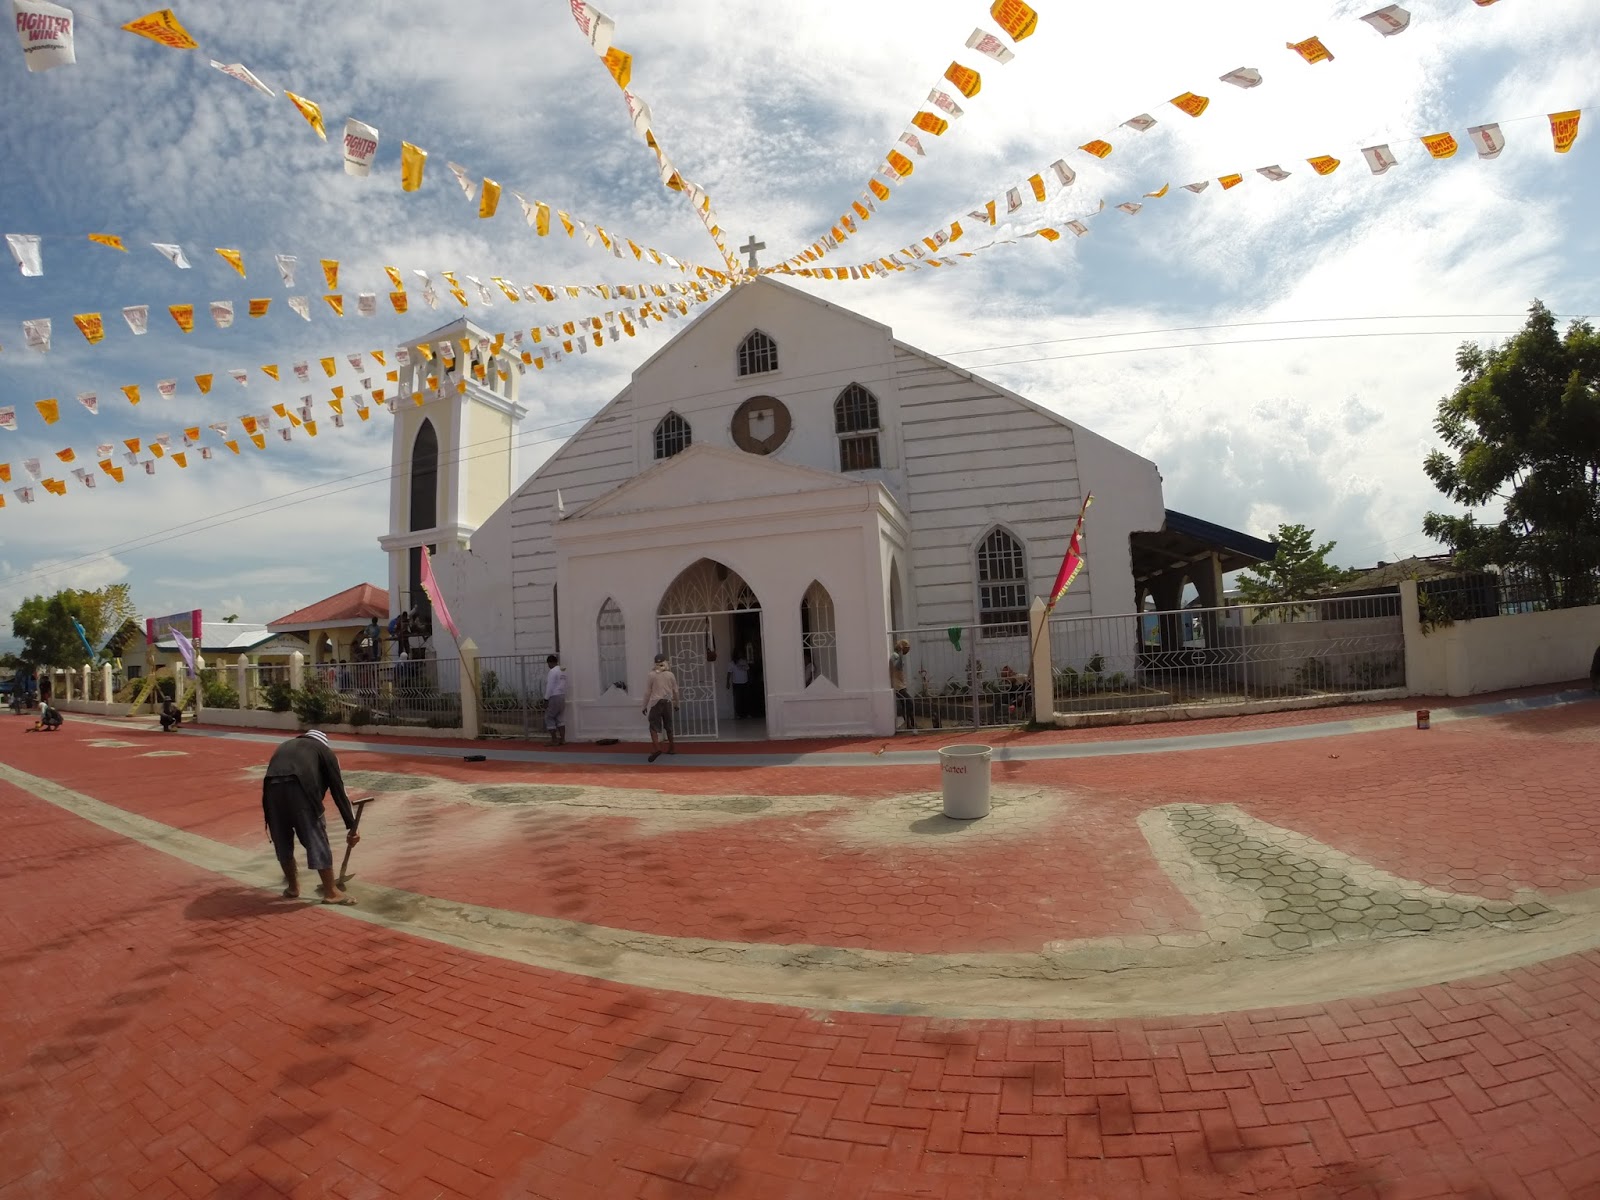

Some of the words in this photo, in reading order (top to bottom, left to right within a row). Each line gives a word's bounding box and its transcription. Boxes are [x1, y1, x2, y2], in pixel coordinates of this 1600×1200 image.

[16, 12, 70, 34] FIGHTER
[29, 30, 59, 41] WINE
[344, 134, 377, 155] FIGHTER
[1425, 135, 1455, 152] FIGHTER
[1433, 143, 1455, 155] WINE
[348, 149, 367, 160] WINE
